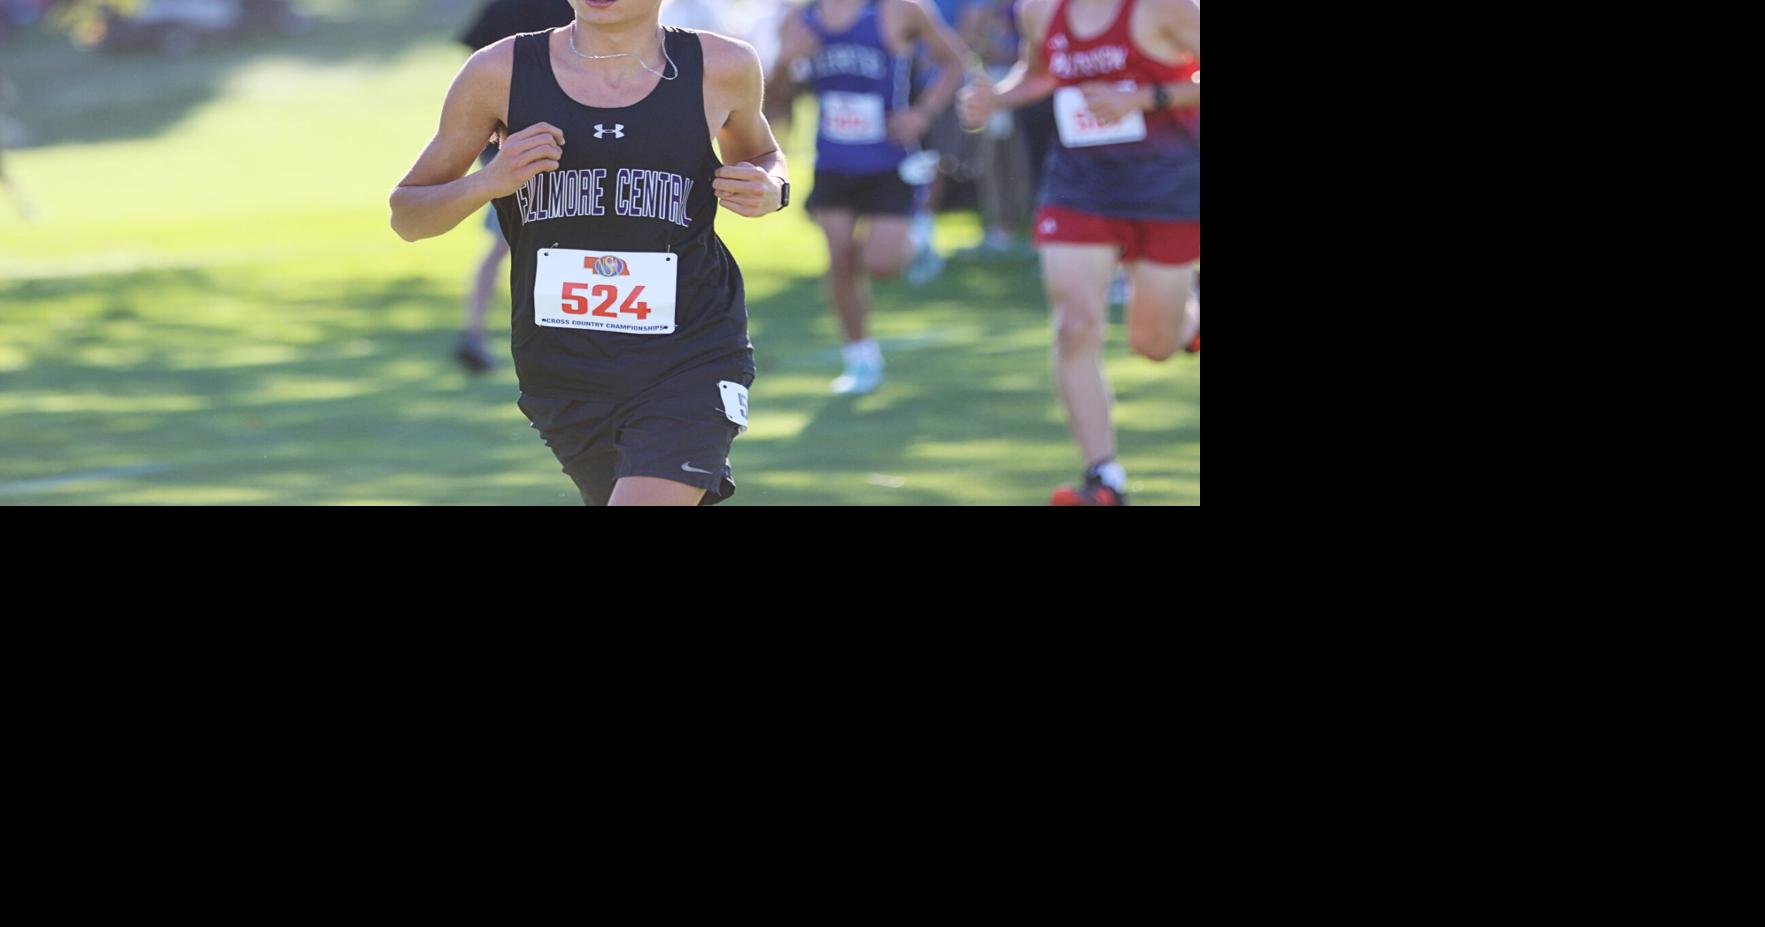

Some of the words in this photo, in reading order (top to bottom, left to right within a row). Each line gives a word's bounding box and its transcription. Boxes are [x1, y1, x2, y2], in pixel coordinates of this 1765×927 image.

[516, 168, 607, 226] FLLMORE
[561, 282, 651, 320] 524
[572, 320, 604, 328] COUNTRY
[605, 323, 664, 331] CHAMPIONSHIPS
